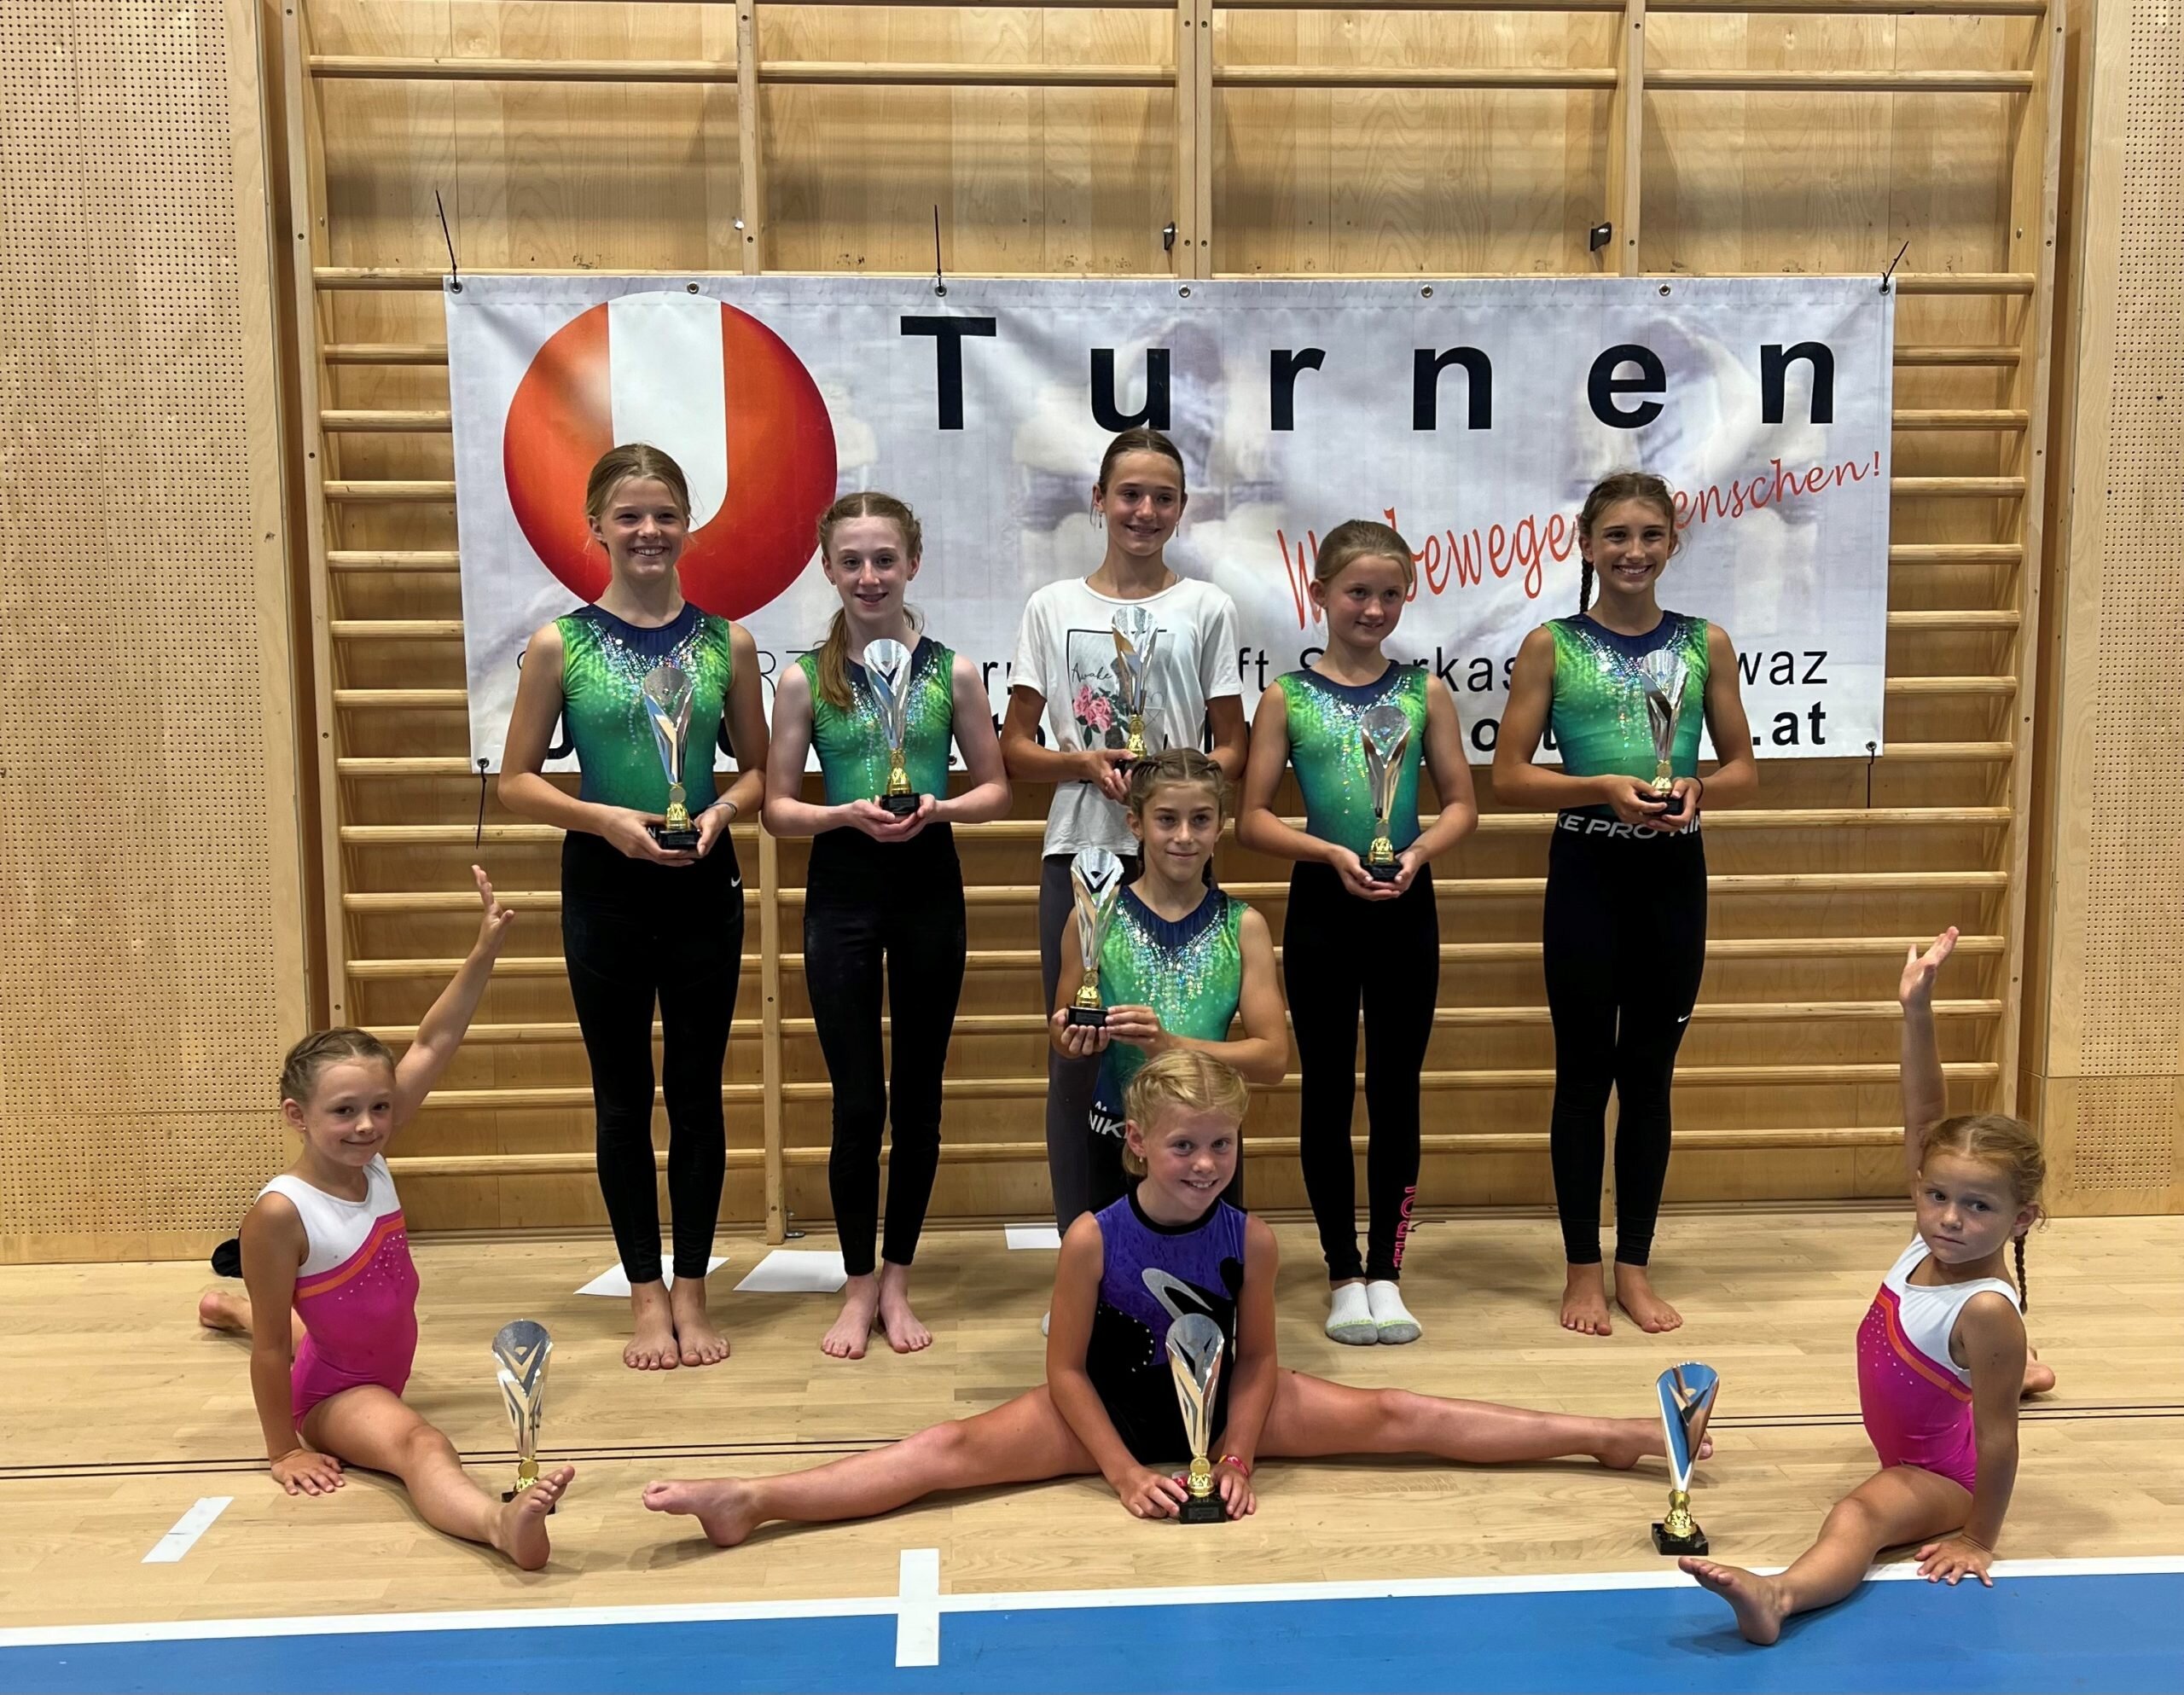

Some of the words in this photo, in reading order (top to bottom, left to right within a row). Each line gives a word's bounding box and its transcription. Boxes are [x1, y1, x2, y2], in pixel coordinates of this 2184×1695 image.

[900, 316, 1834, 432] Turnen
[1673, 450, 1879, 530] enschen!
[1585, 819, 1658, 839] PRO
[1089, 1110, 1127, 1139] NIK
